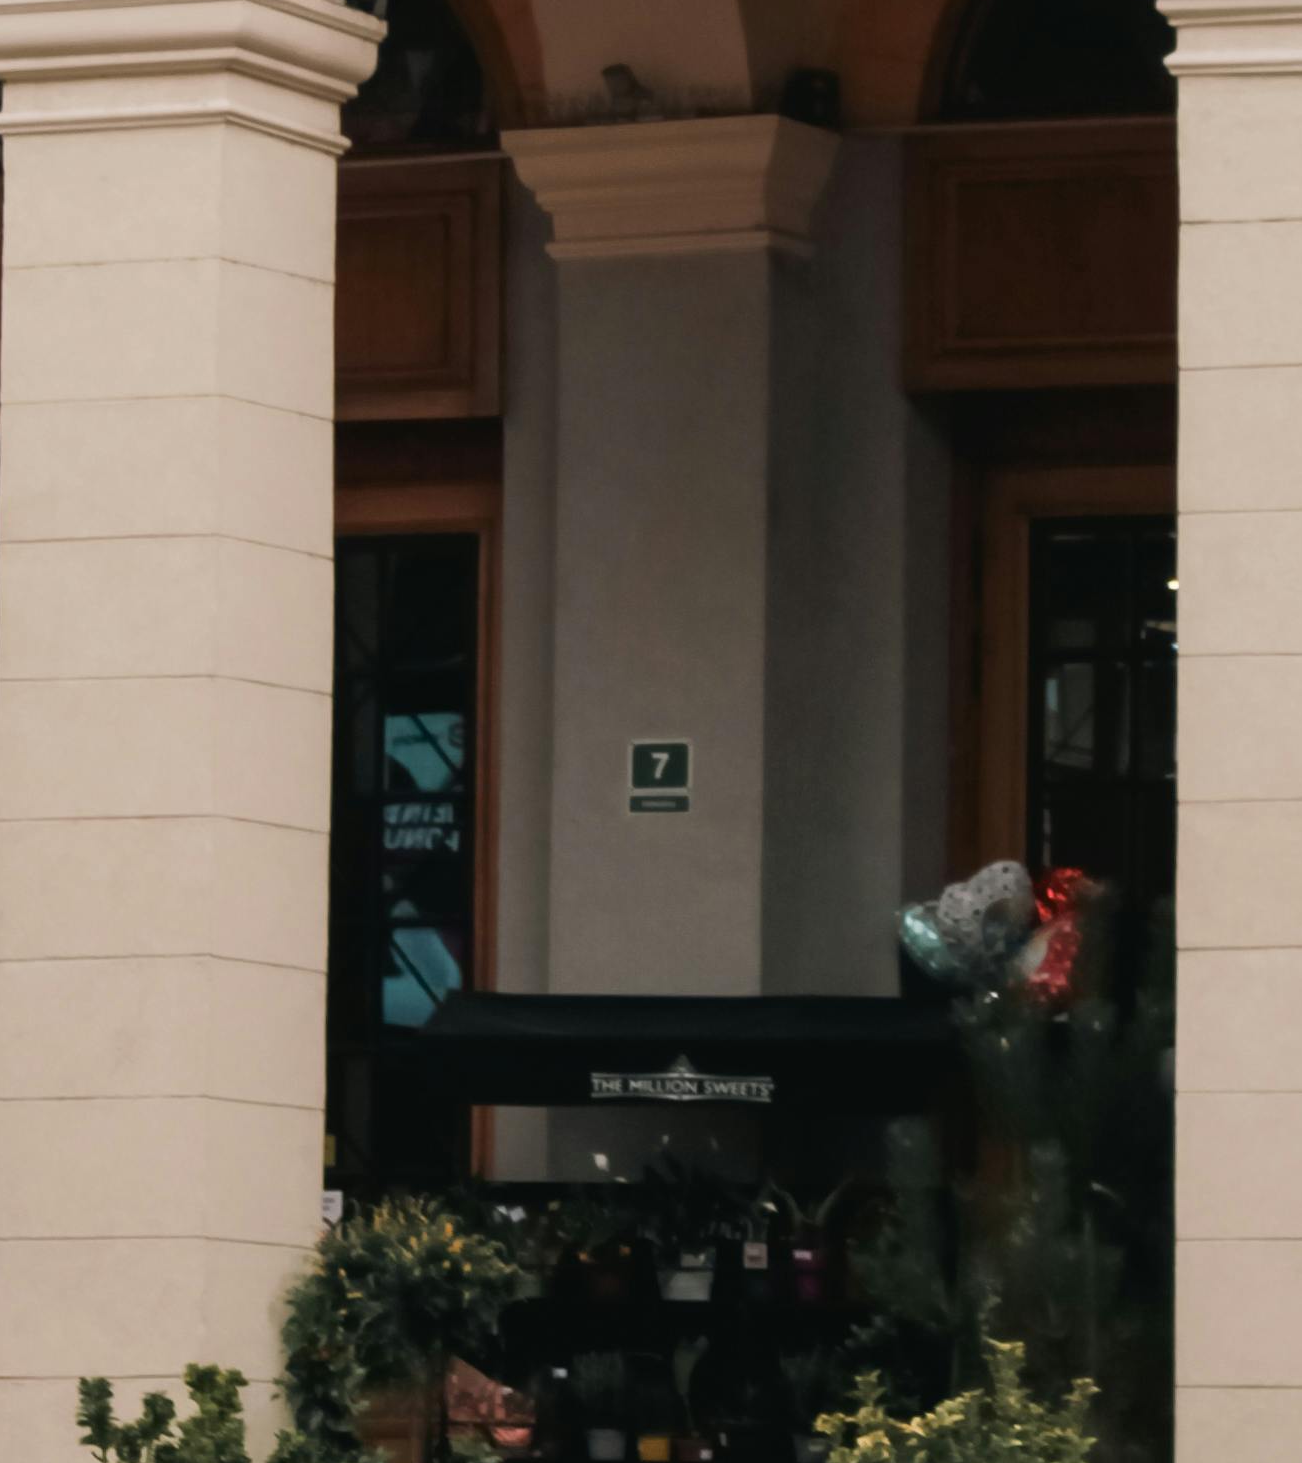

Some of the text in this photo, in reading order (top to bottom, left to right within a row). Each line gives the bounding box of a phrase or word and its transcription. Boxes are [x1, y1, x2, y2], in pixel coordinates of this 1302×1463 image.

[651, 752, 669, 779] 7
[592, 1078, 769, 1097] THE MILLION SWEETS
